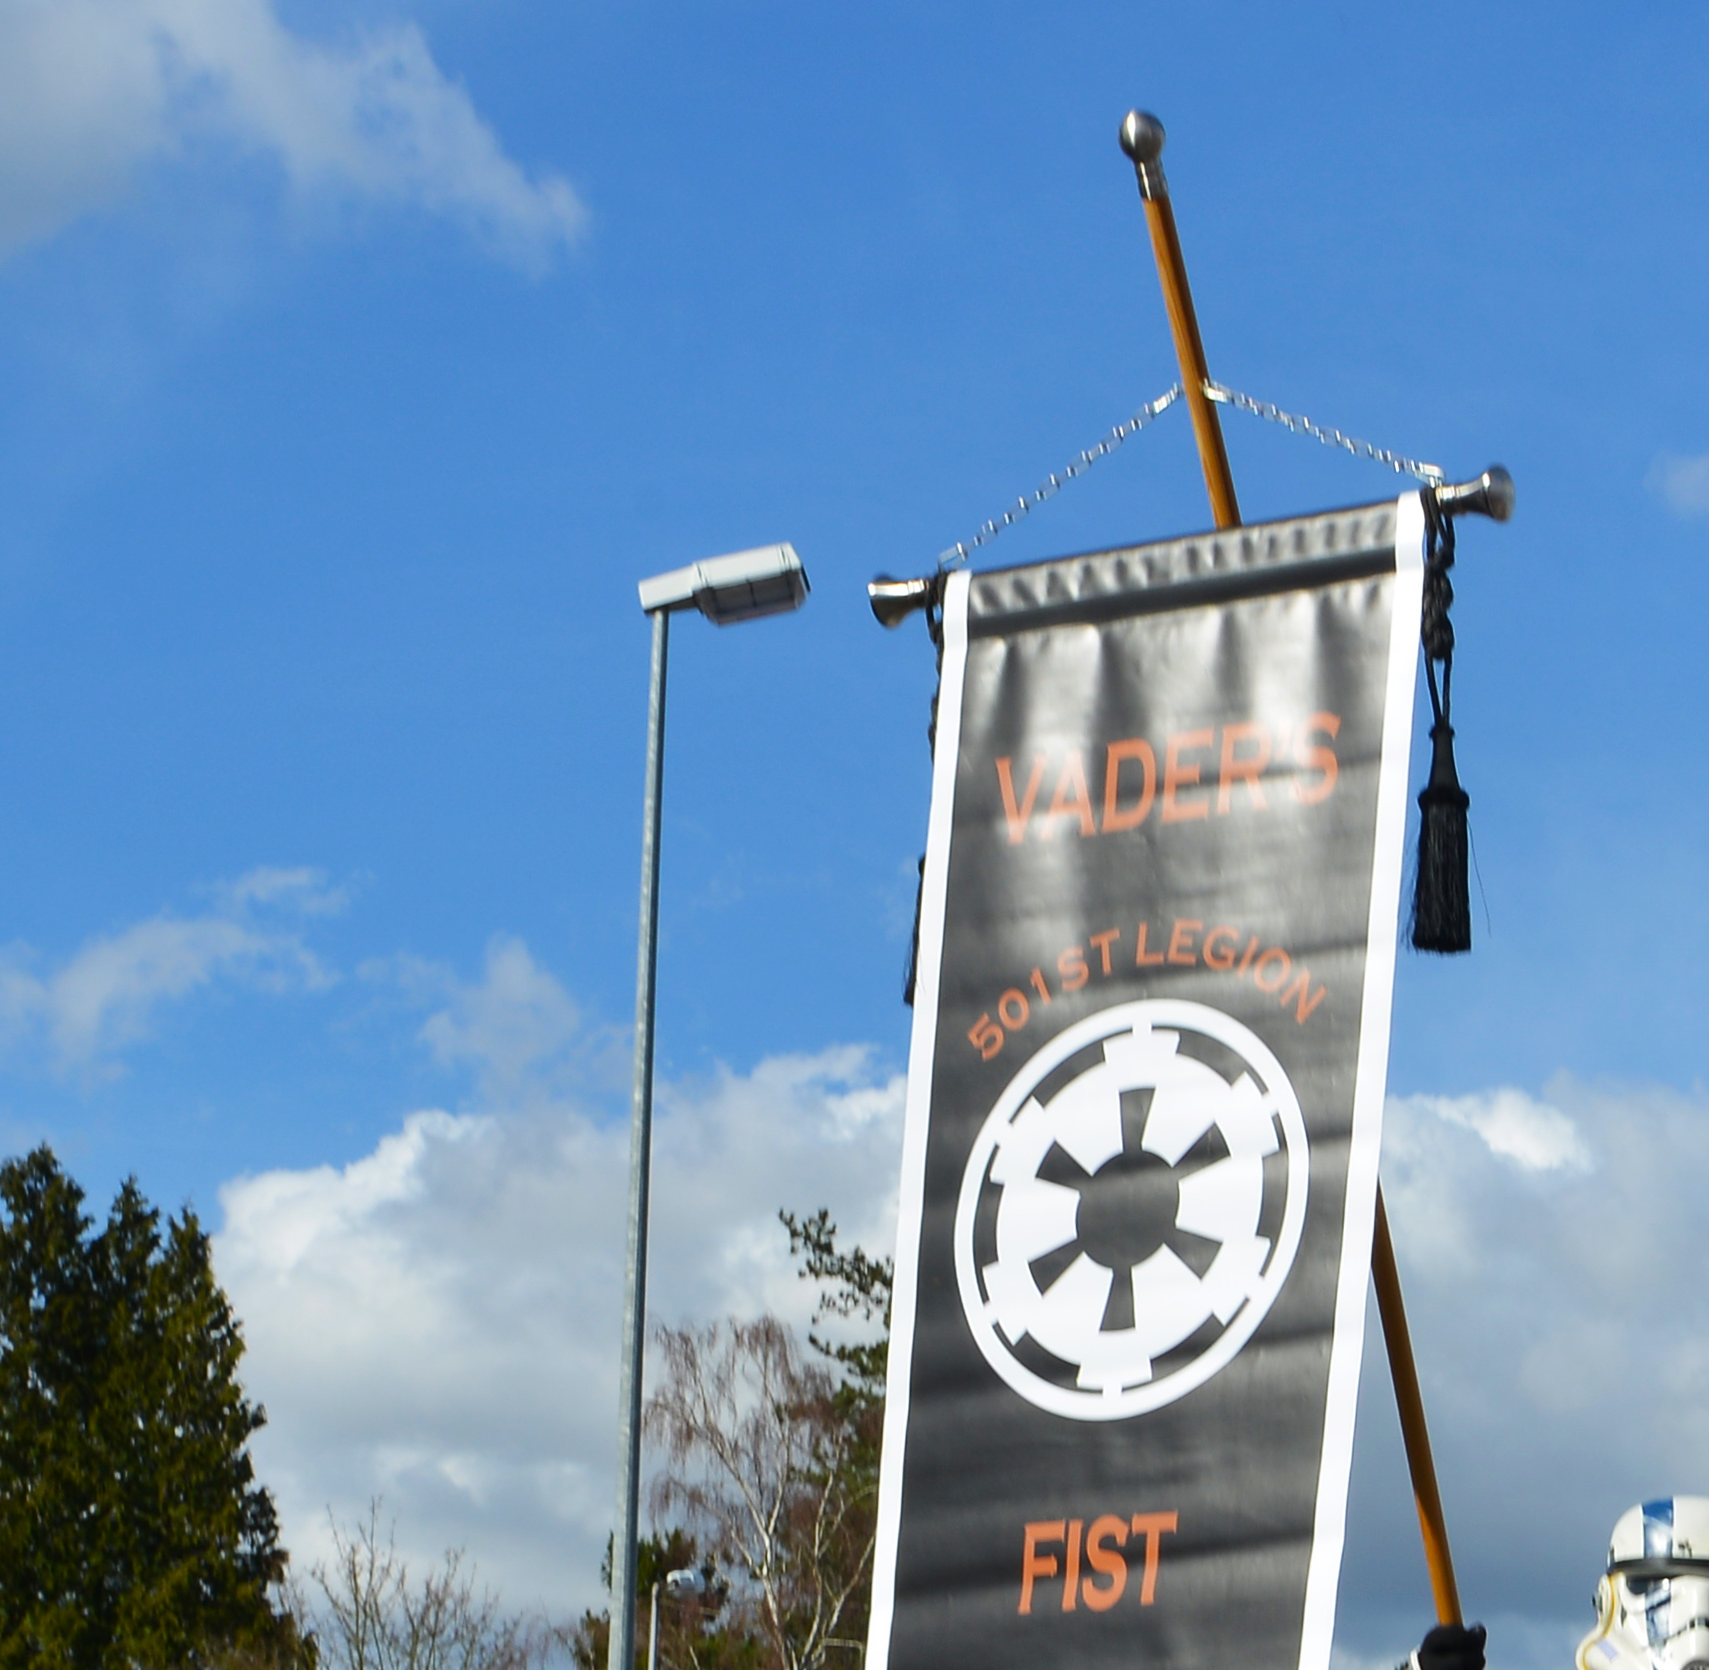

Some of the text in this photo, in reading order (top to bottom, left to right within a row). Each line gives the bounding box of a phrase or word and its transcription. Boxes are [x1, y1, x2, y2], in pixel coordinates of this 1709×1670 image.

[995, 711, 1341, 845] VADER'S
[967, 918, 1328, 1061] 501ST LEGION
[1017, 1510, 1179, 1616] FIST
